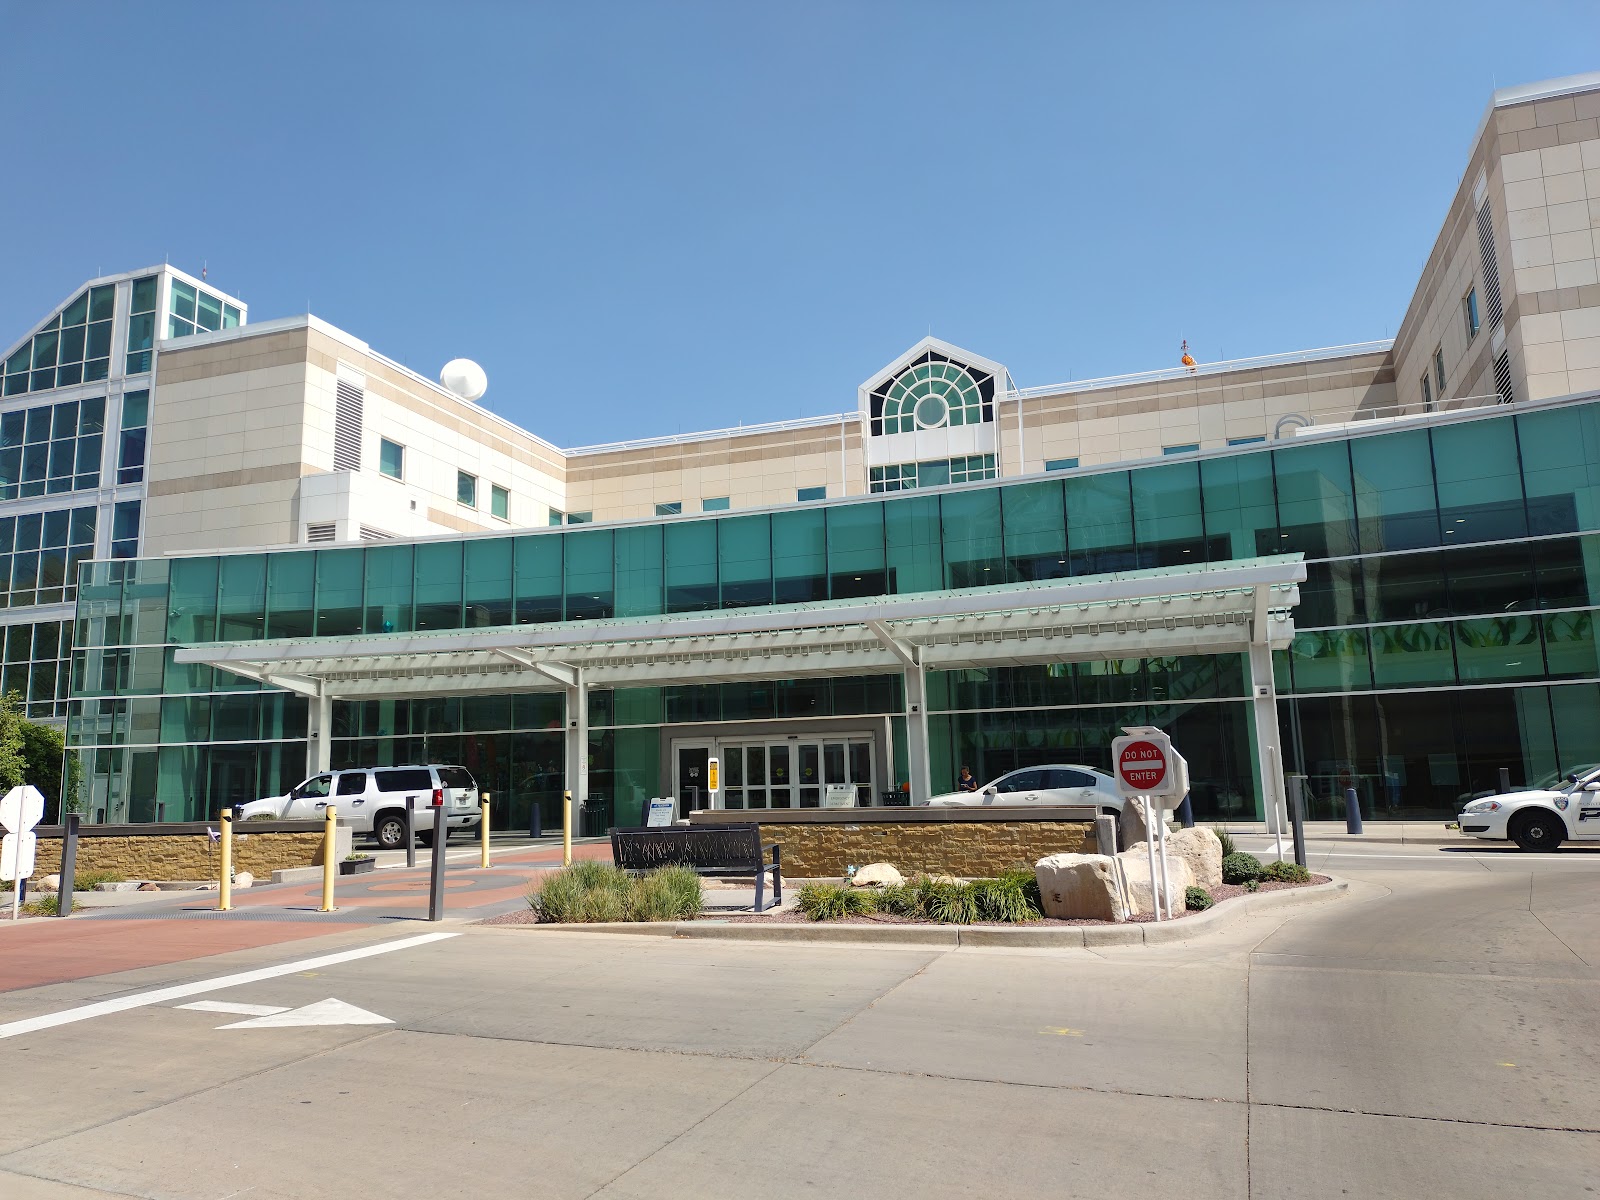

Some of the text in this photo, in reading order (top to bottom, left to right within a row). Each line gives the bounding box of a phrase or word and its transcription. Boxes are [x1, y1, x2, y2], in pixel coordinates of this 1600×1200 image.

[1125, 749, 1158, 760] DO NOT
[1130, 771, 1157, 781] ENTER
